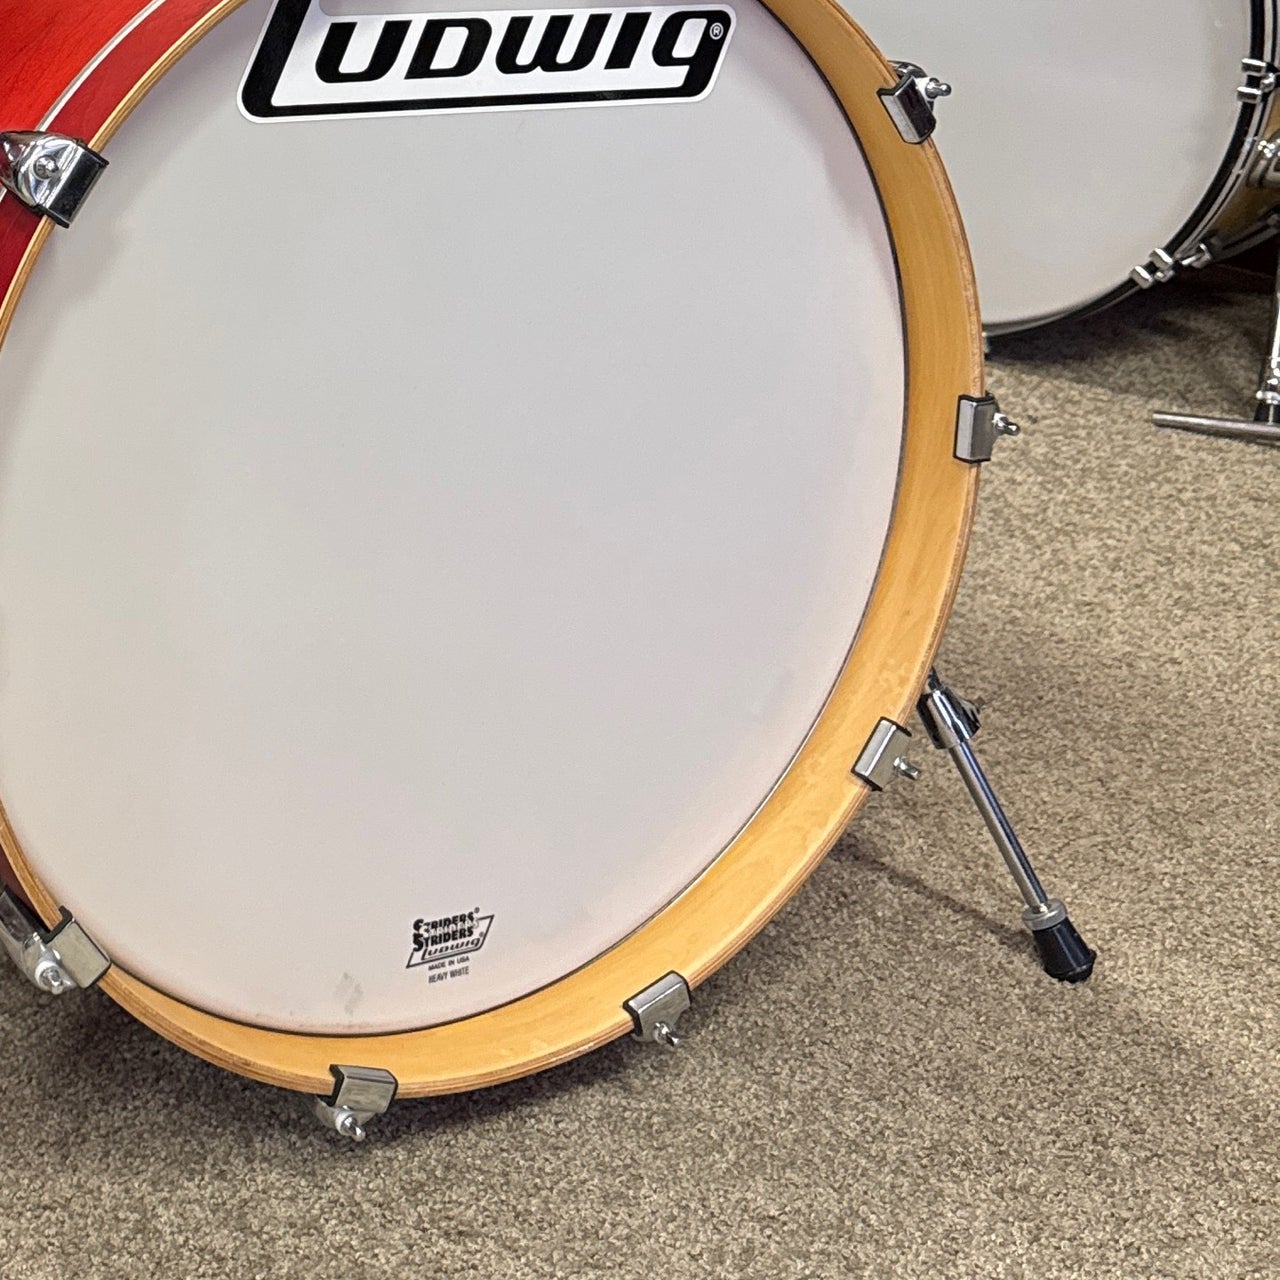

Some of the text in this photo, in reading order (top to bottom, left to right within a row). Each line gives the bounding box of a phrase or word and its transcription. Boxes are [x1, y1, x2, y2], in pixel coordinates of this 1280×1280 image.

[413, 926, 474, 952] STRIDERS
[428, 955, 470, 971] MADE IN USA
[428, 965, 470, 984] HEAVY WHITE
